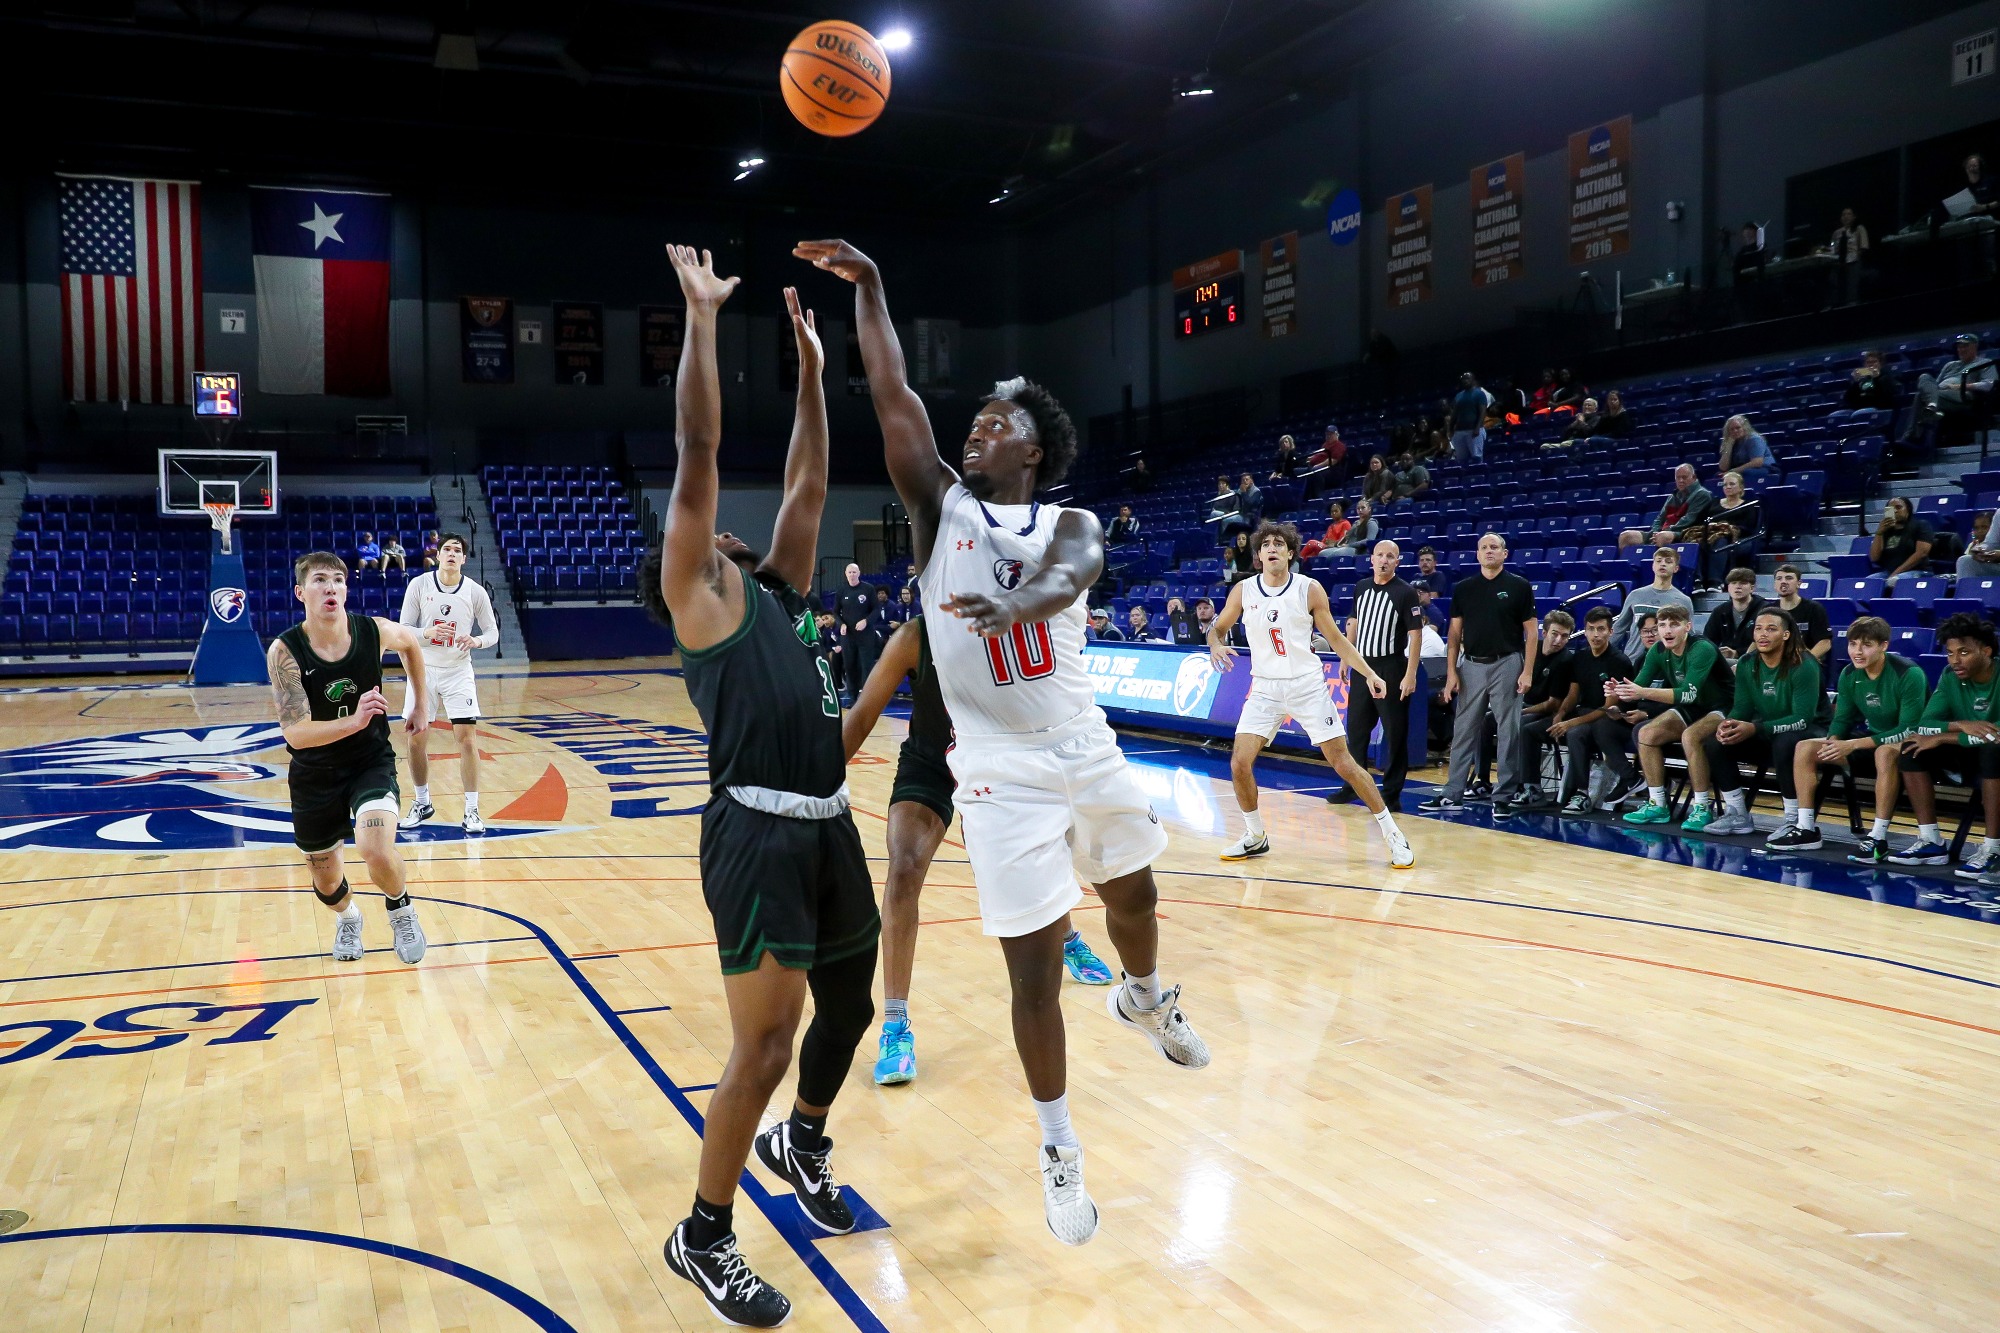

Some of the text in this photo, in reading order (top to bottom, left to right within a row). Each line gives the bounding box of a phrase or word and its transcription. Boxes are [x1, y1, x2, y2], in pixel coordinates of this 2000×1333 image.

[816, 33, 881, 83] Wilson
[1967, 53, 1982, 76] 11
[1589, 140, 1611, 154] NCAA
[1576, 173, 1623, 200] NATIONAL
[1572, 190, 1627, 218] CHAMPION
[1330, 211, 1361, 236] NCAA
[1476, 205, 1518, 229] NATIONAL
[1474, 221, 1521, 245] CHAMPION
[1392, 236, 1427, 257] NATIONAL
[1585, 238, 1612, 259] 2016
[1387, 250, 1433, 273] CHAMPIONS
[1265, 274, 1294, 291] NATIONAL
[1485, 265, 1509, 284] 2015
[1196, 281, 1219, 303] 17:47
[1263, 287, 1296, 306] CHAMPION
[230, 319, 236, 331] 7
[1228, 304, 1237, 323] 6
[528, 331, 534, 341] 8
[1184, 317, 1193, 334] 0
[201, 376, 237, 390] 17:47
[216, 390, 233, 413] 6
[977, 620, 1058, 687] 10
[1269, 627, 1287, 658] 6
[1091, 654, 1111, 674] TO
[1110, 656, 1140, 677] THE
[1117, 677, 1173, 701] CENTER
